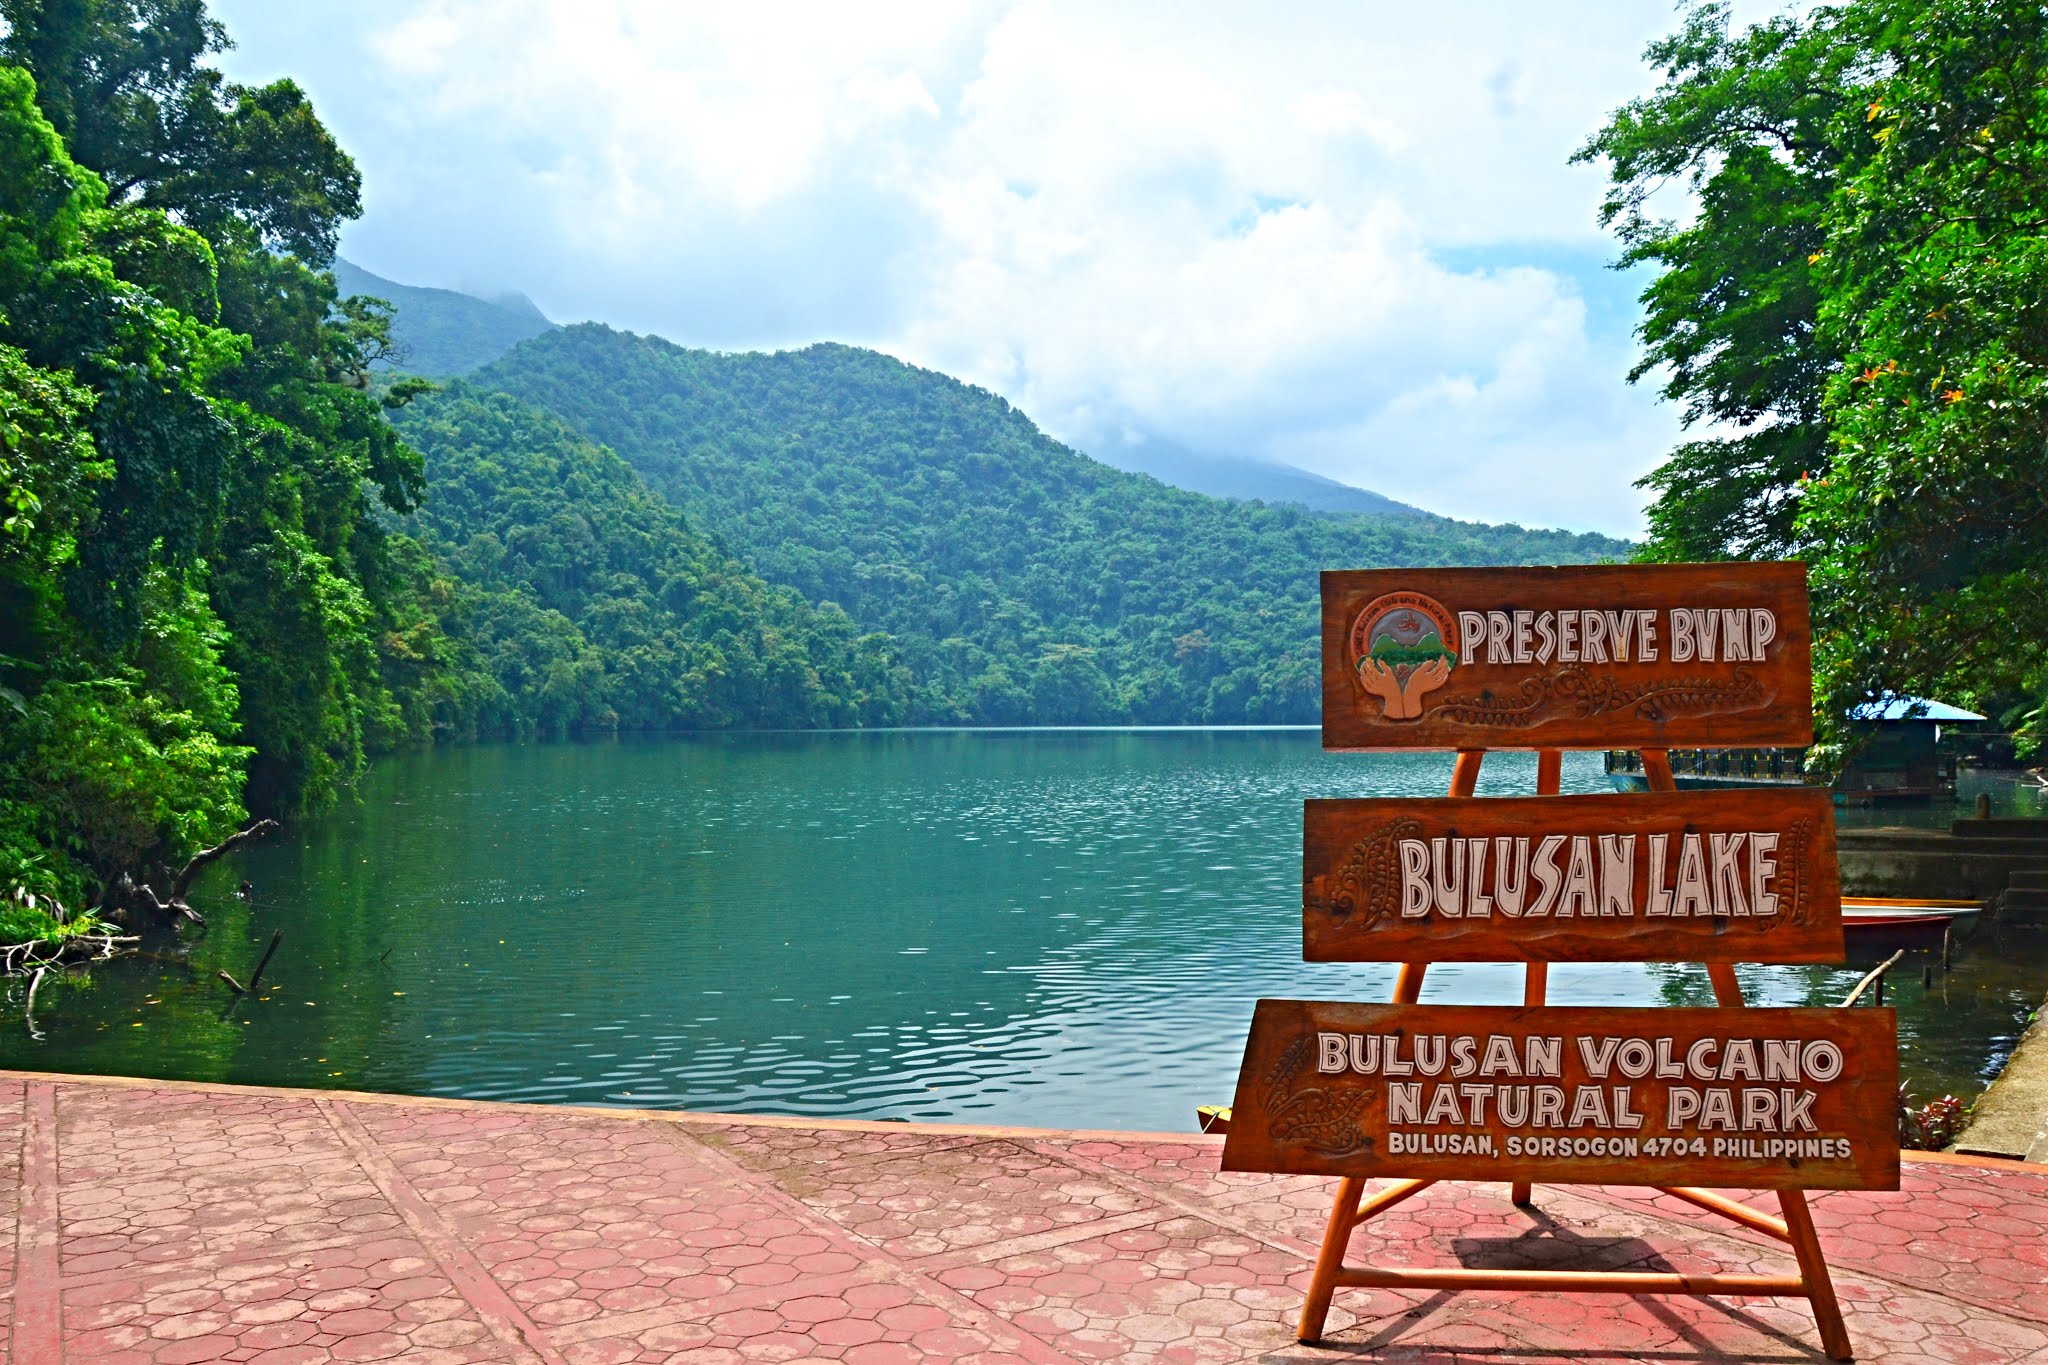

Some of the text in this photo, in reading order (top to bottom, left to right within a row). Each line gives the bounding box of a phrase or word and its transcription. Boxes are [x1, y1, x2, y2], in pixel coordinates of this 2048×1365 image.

[1457, 607, 1776, 666] PRESERVE BVNP
[1398, 832, 1780, 918] BULUSAN LAKE
[1317, 1032, 1843, 1083] BULUSAN VOLCANO
[1387, 1081, 1818, 1132] NATURAL PARK
[1388, 1132, 1851, 1159] BULUSAN, SORSOGON 4704 PHILIPPINES
